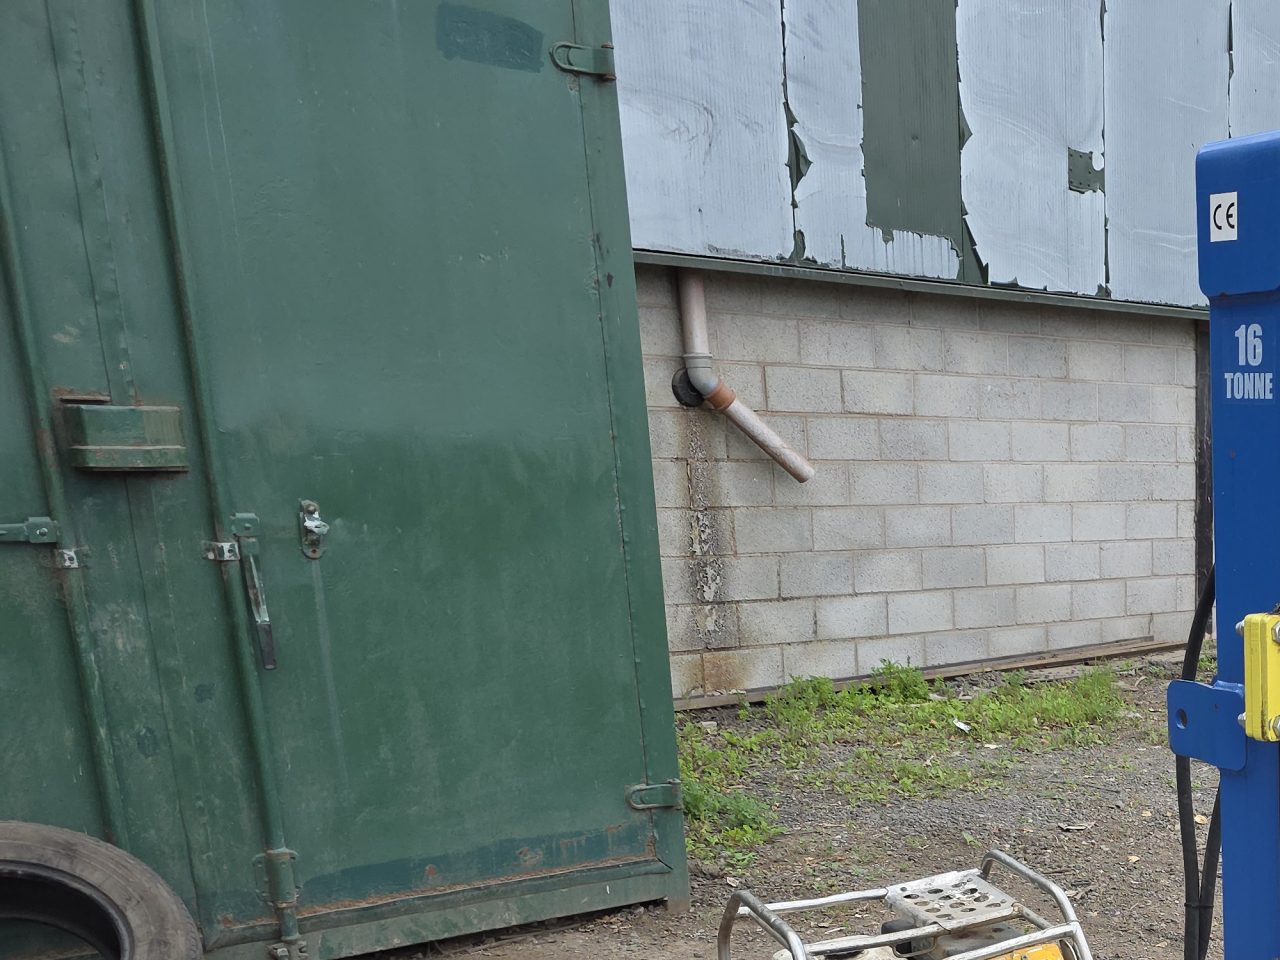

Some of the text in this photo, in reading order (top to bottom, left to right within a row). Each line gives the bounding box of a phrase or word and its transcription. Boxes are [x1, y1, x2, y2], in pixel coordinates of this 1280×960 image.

[1213, 202, 1235, 230] CE
[1234, 323, 1263, 366] 16
[1224, 372, 1273, 400] TONNE
